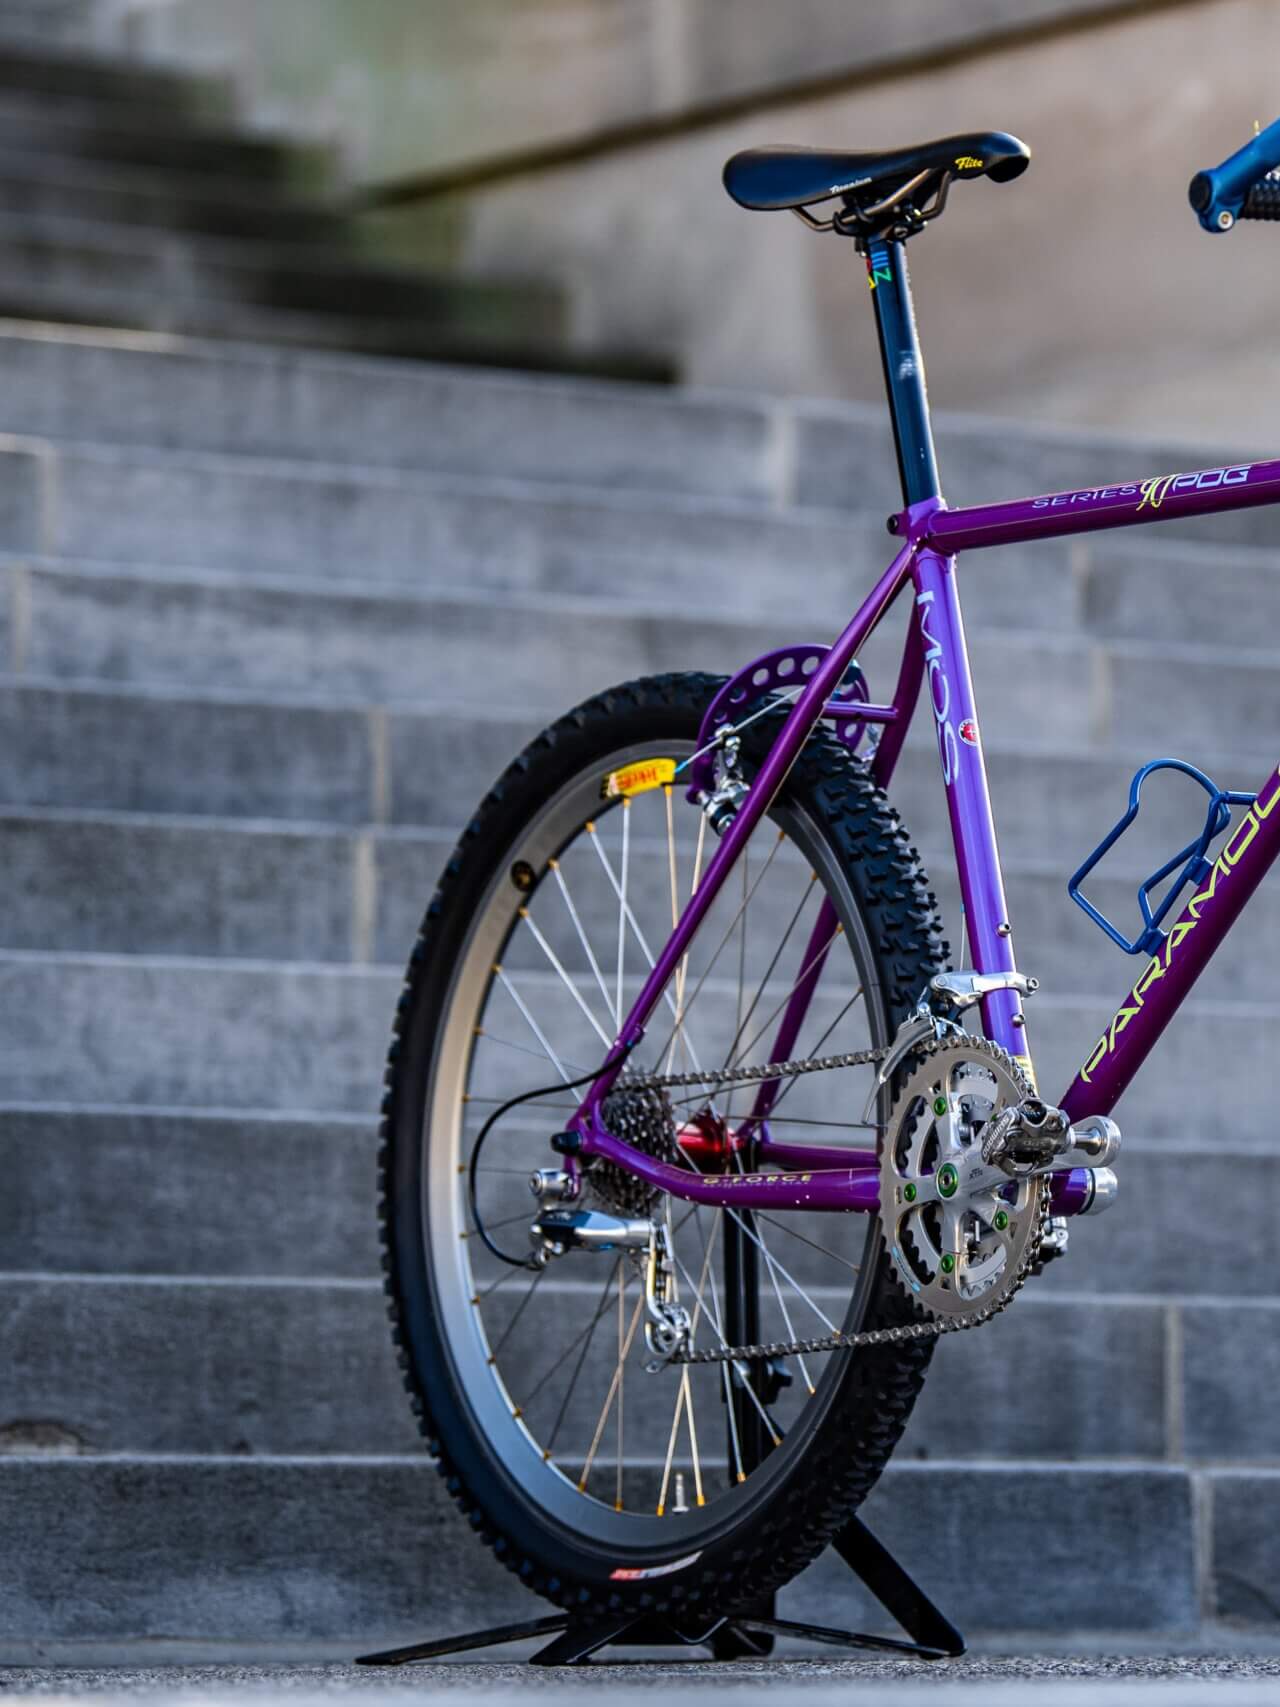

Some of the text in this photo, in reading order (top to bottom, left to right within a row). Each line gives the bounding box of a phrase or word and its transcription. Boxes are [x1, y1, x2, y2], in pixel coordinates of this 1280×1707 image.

[955, 156, 983, 170] Flite
[1031, 485, 1137, 509] SERIES
[703, 1174, 812, 1185] G-FORCE
